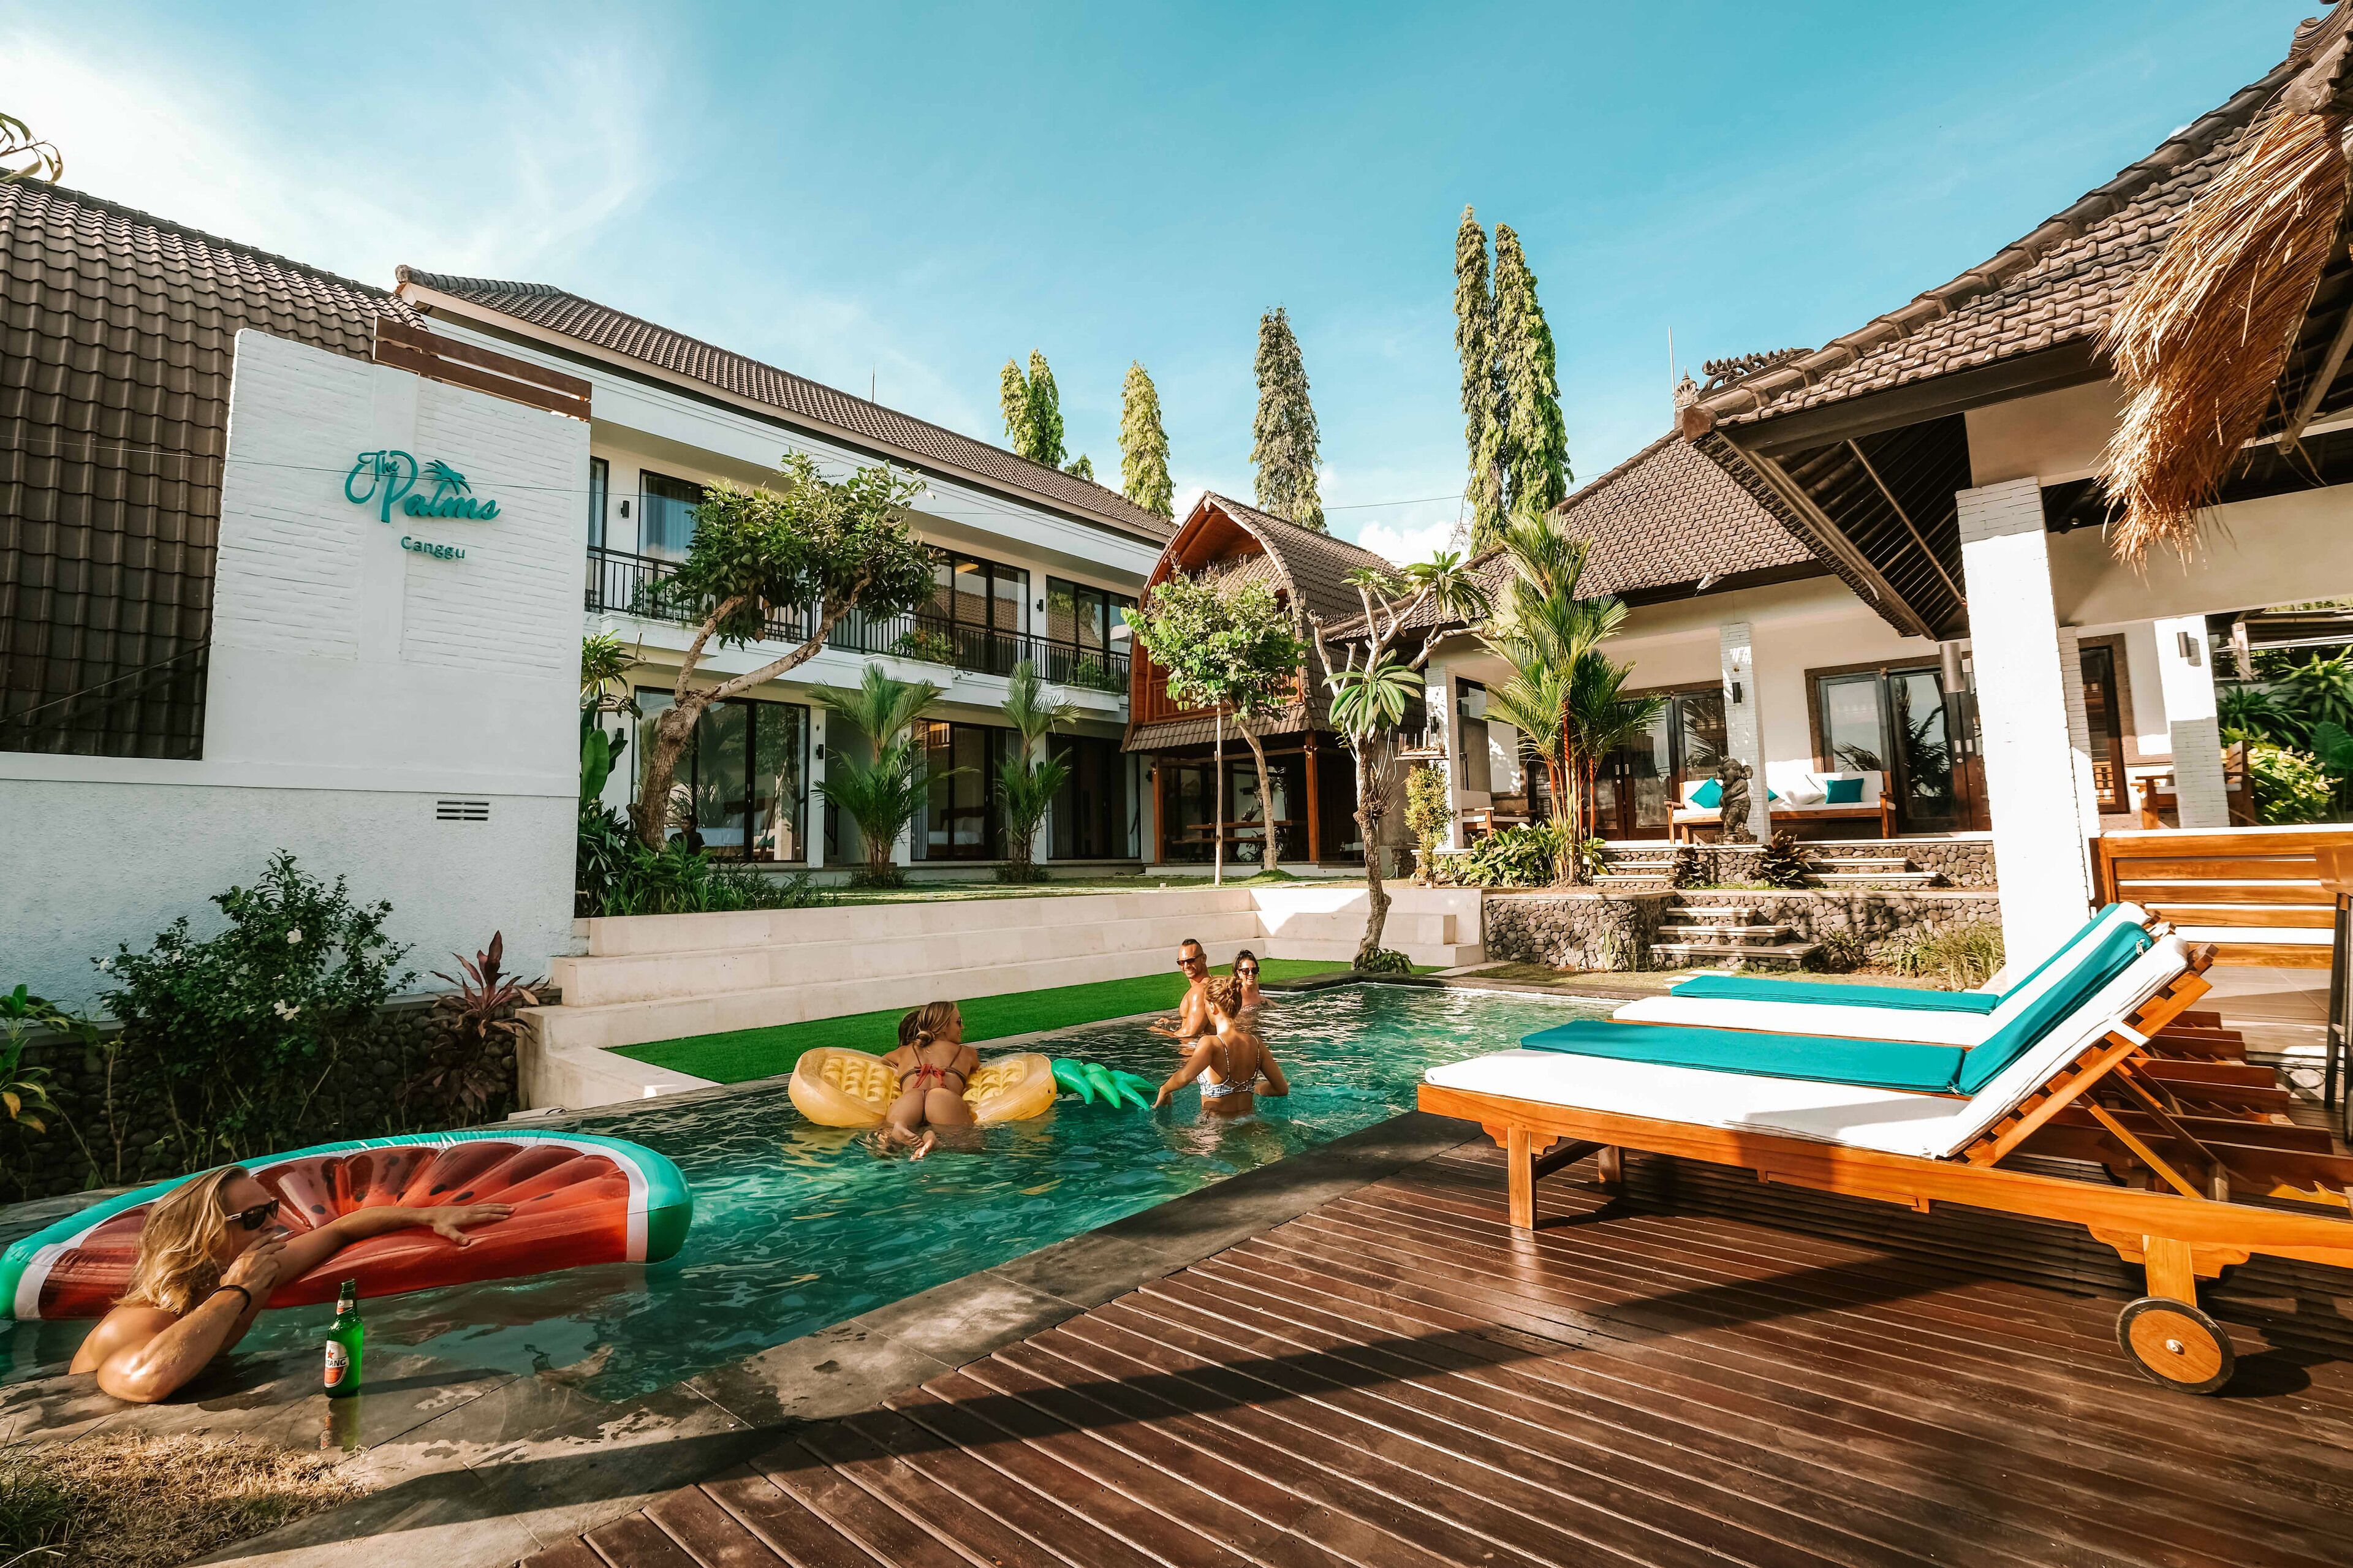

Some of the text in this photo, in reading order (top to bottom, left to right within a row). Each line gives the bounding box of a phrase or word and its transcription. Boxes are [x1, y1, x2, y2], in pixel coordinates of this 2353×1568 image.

[344, 450, 501, 523] The Palms
[401, 536, 465, 559] Canggu
